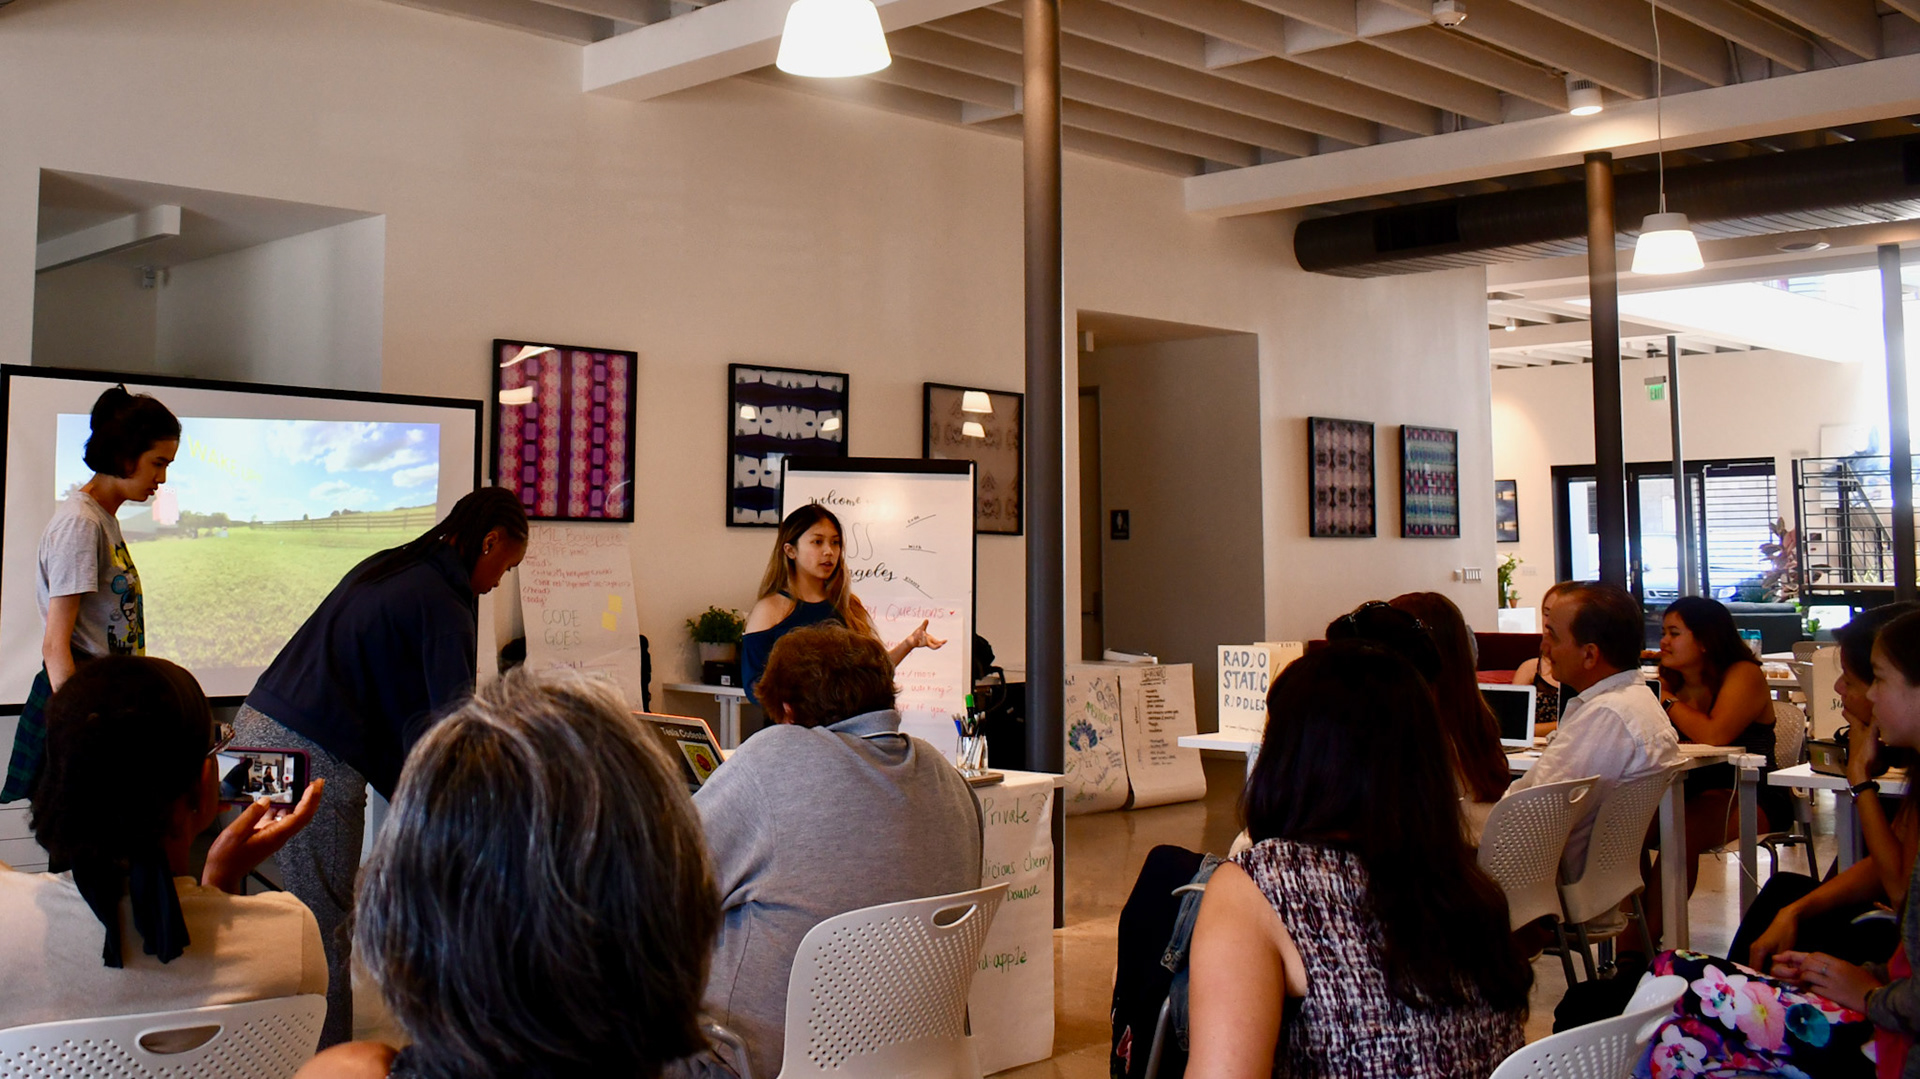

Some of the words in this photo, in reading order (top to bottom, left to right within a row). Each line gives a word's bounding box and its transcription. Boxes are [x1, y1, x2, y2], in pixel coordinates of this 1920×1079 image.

[187, 433, 238, 477] WAKE
[808, 489, 861, 507] welcome
[528, 525, 562, 542] TML
[849, 562, 897, 583] ngeles
[542, 609, 581, 627] CODE
[886, 603, 944, 622] Questions
[544, 629, 581, 647] GOES
[983, 796, 1030, 828] Private
[982, 857, 1015, 880] licious
